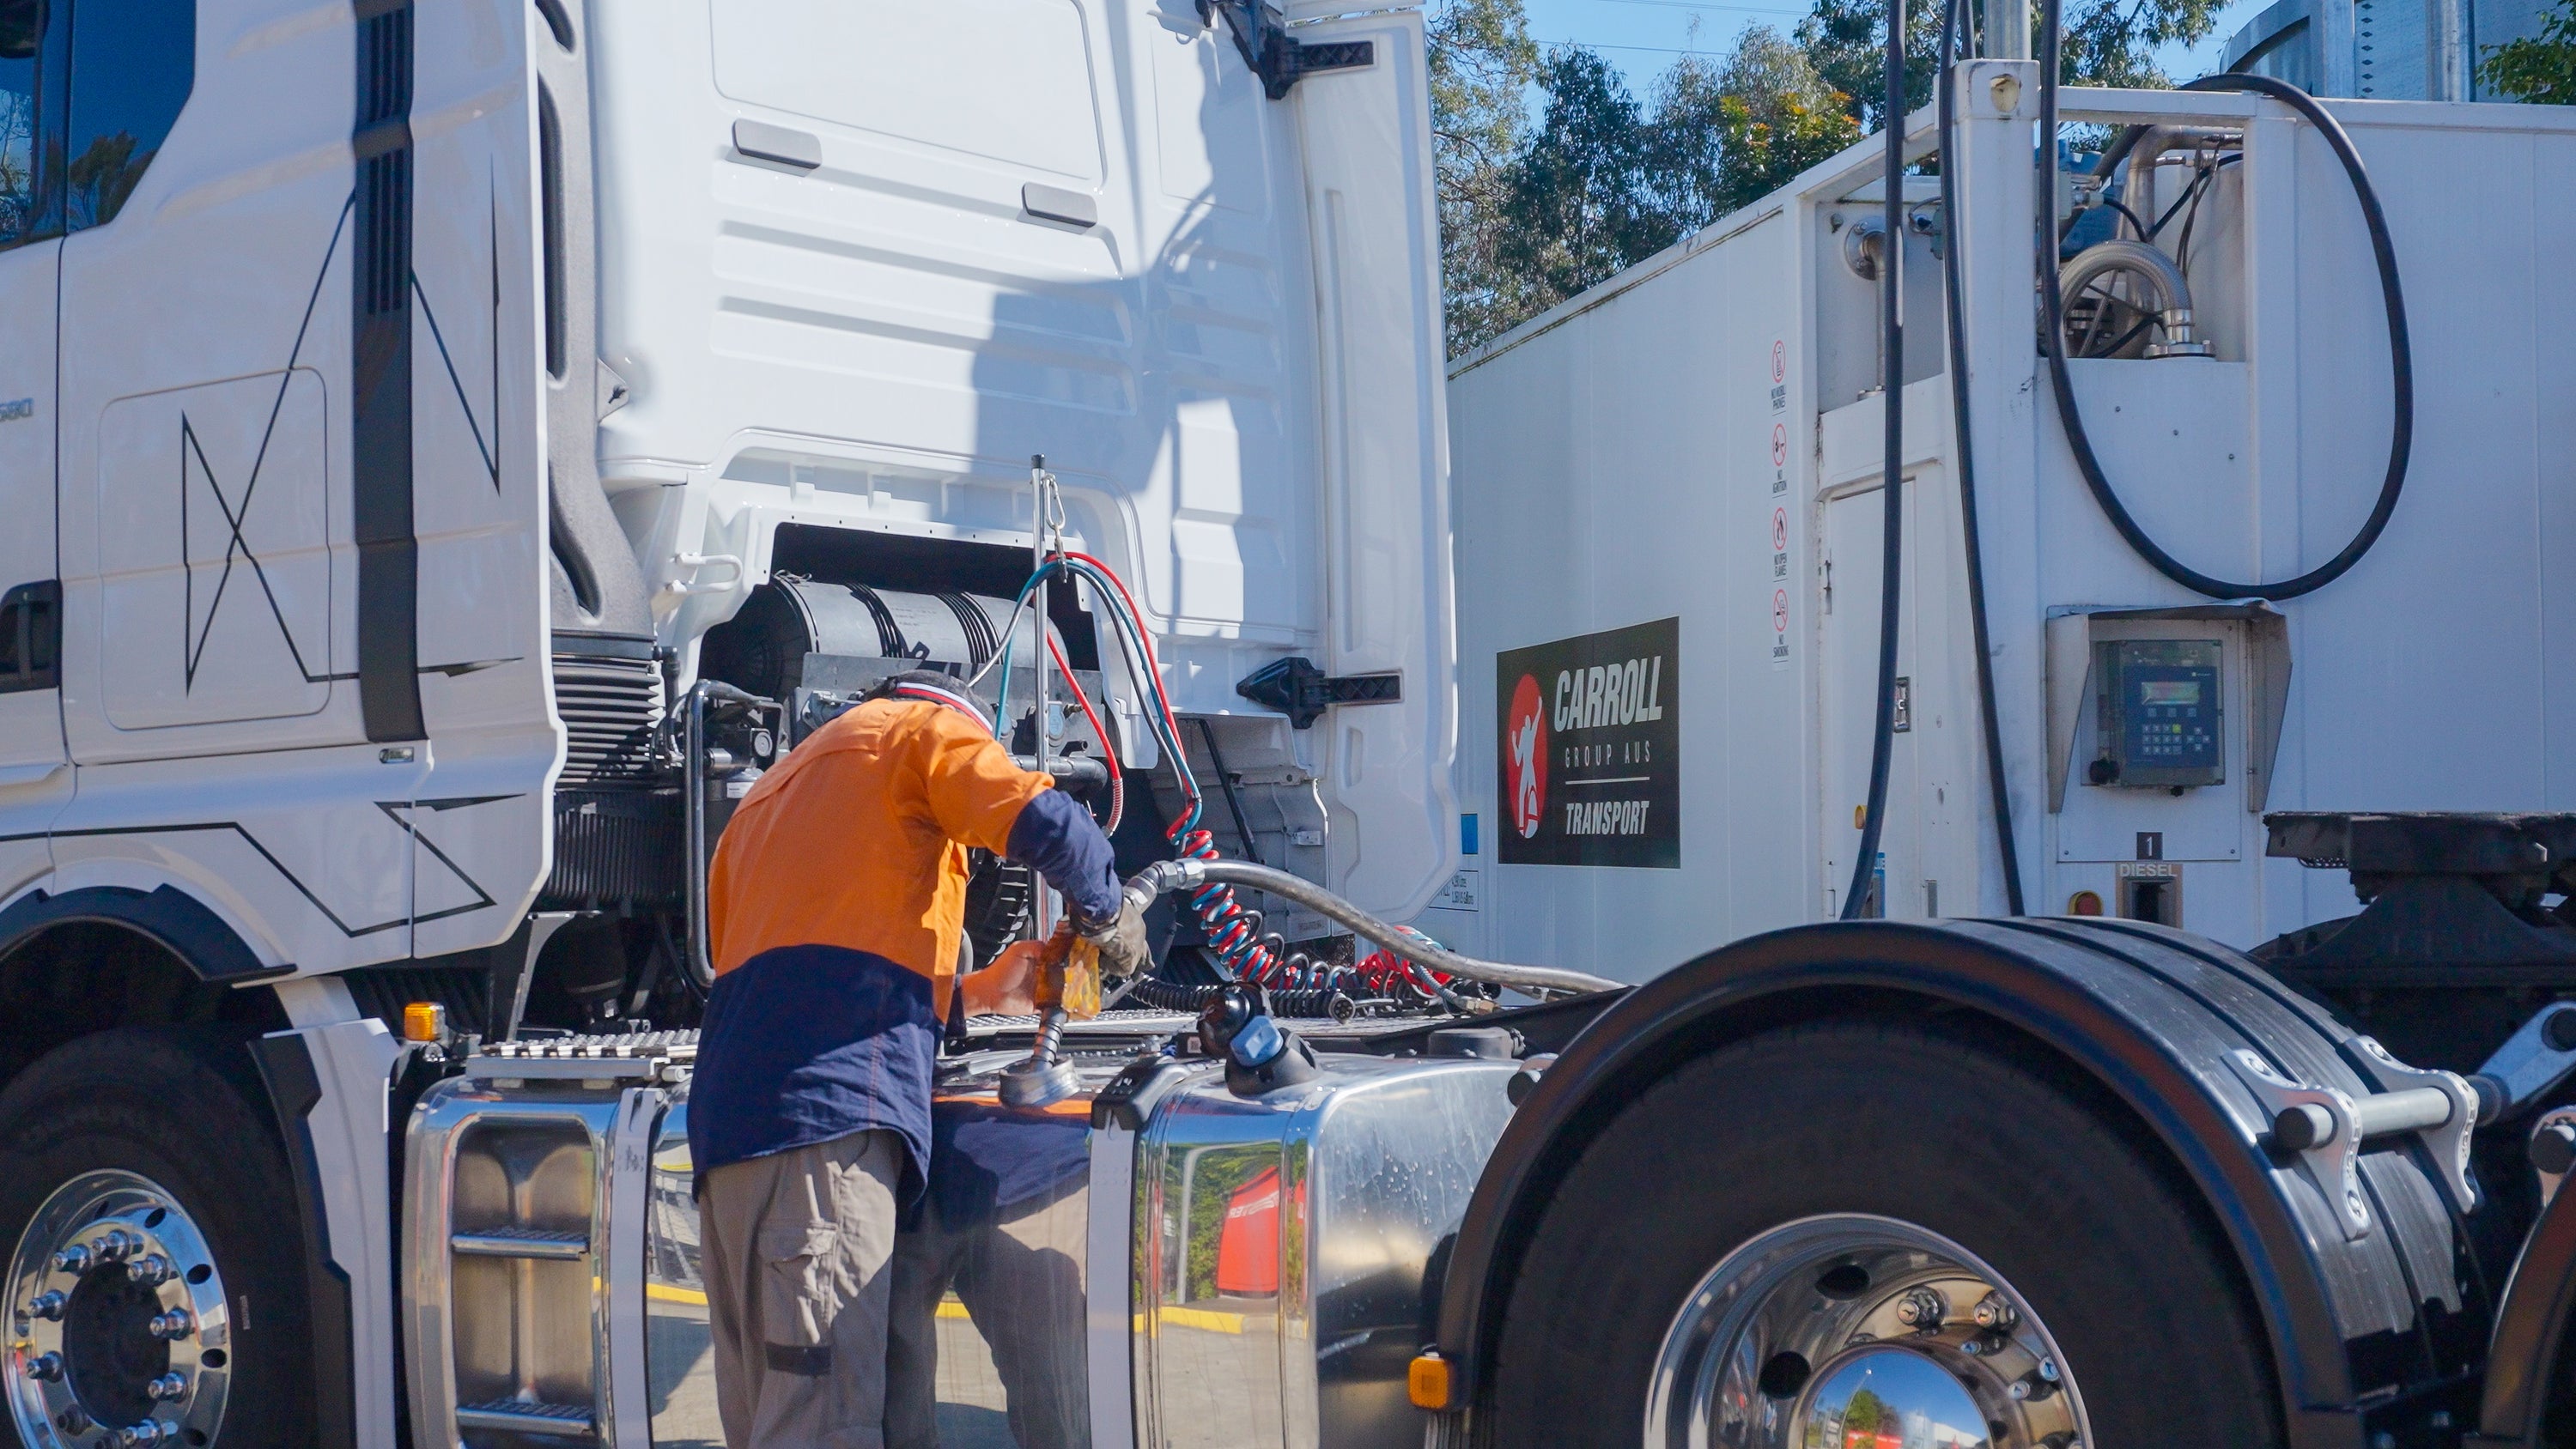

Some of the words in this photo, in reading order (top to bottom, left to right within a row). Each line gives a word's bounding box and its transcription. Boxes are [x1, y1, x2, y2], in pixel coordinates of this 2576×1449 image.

[1554, 656, 1662, 732] CARROLL
[1565, 743, 1612, 768] GROUP
[1625, 740, 1650, 764] AUS
[1565, 800, 1650, 835] TRANSPORT
[2147, 836, 2153, 857] 1
[2120, 863, 2178, 876] DIESEL
